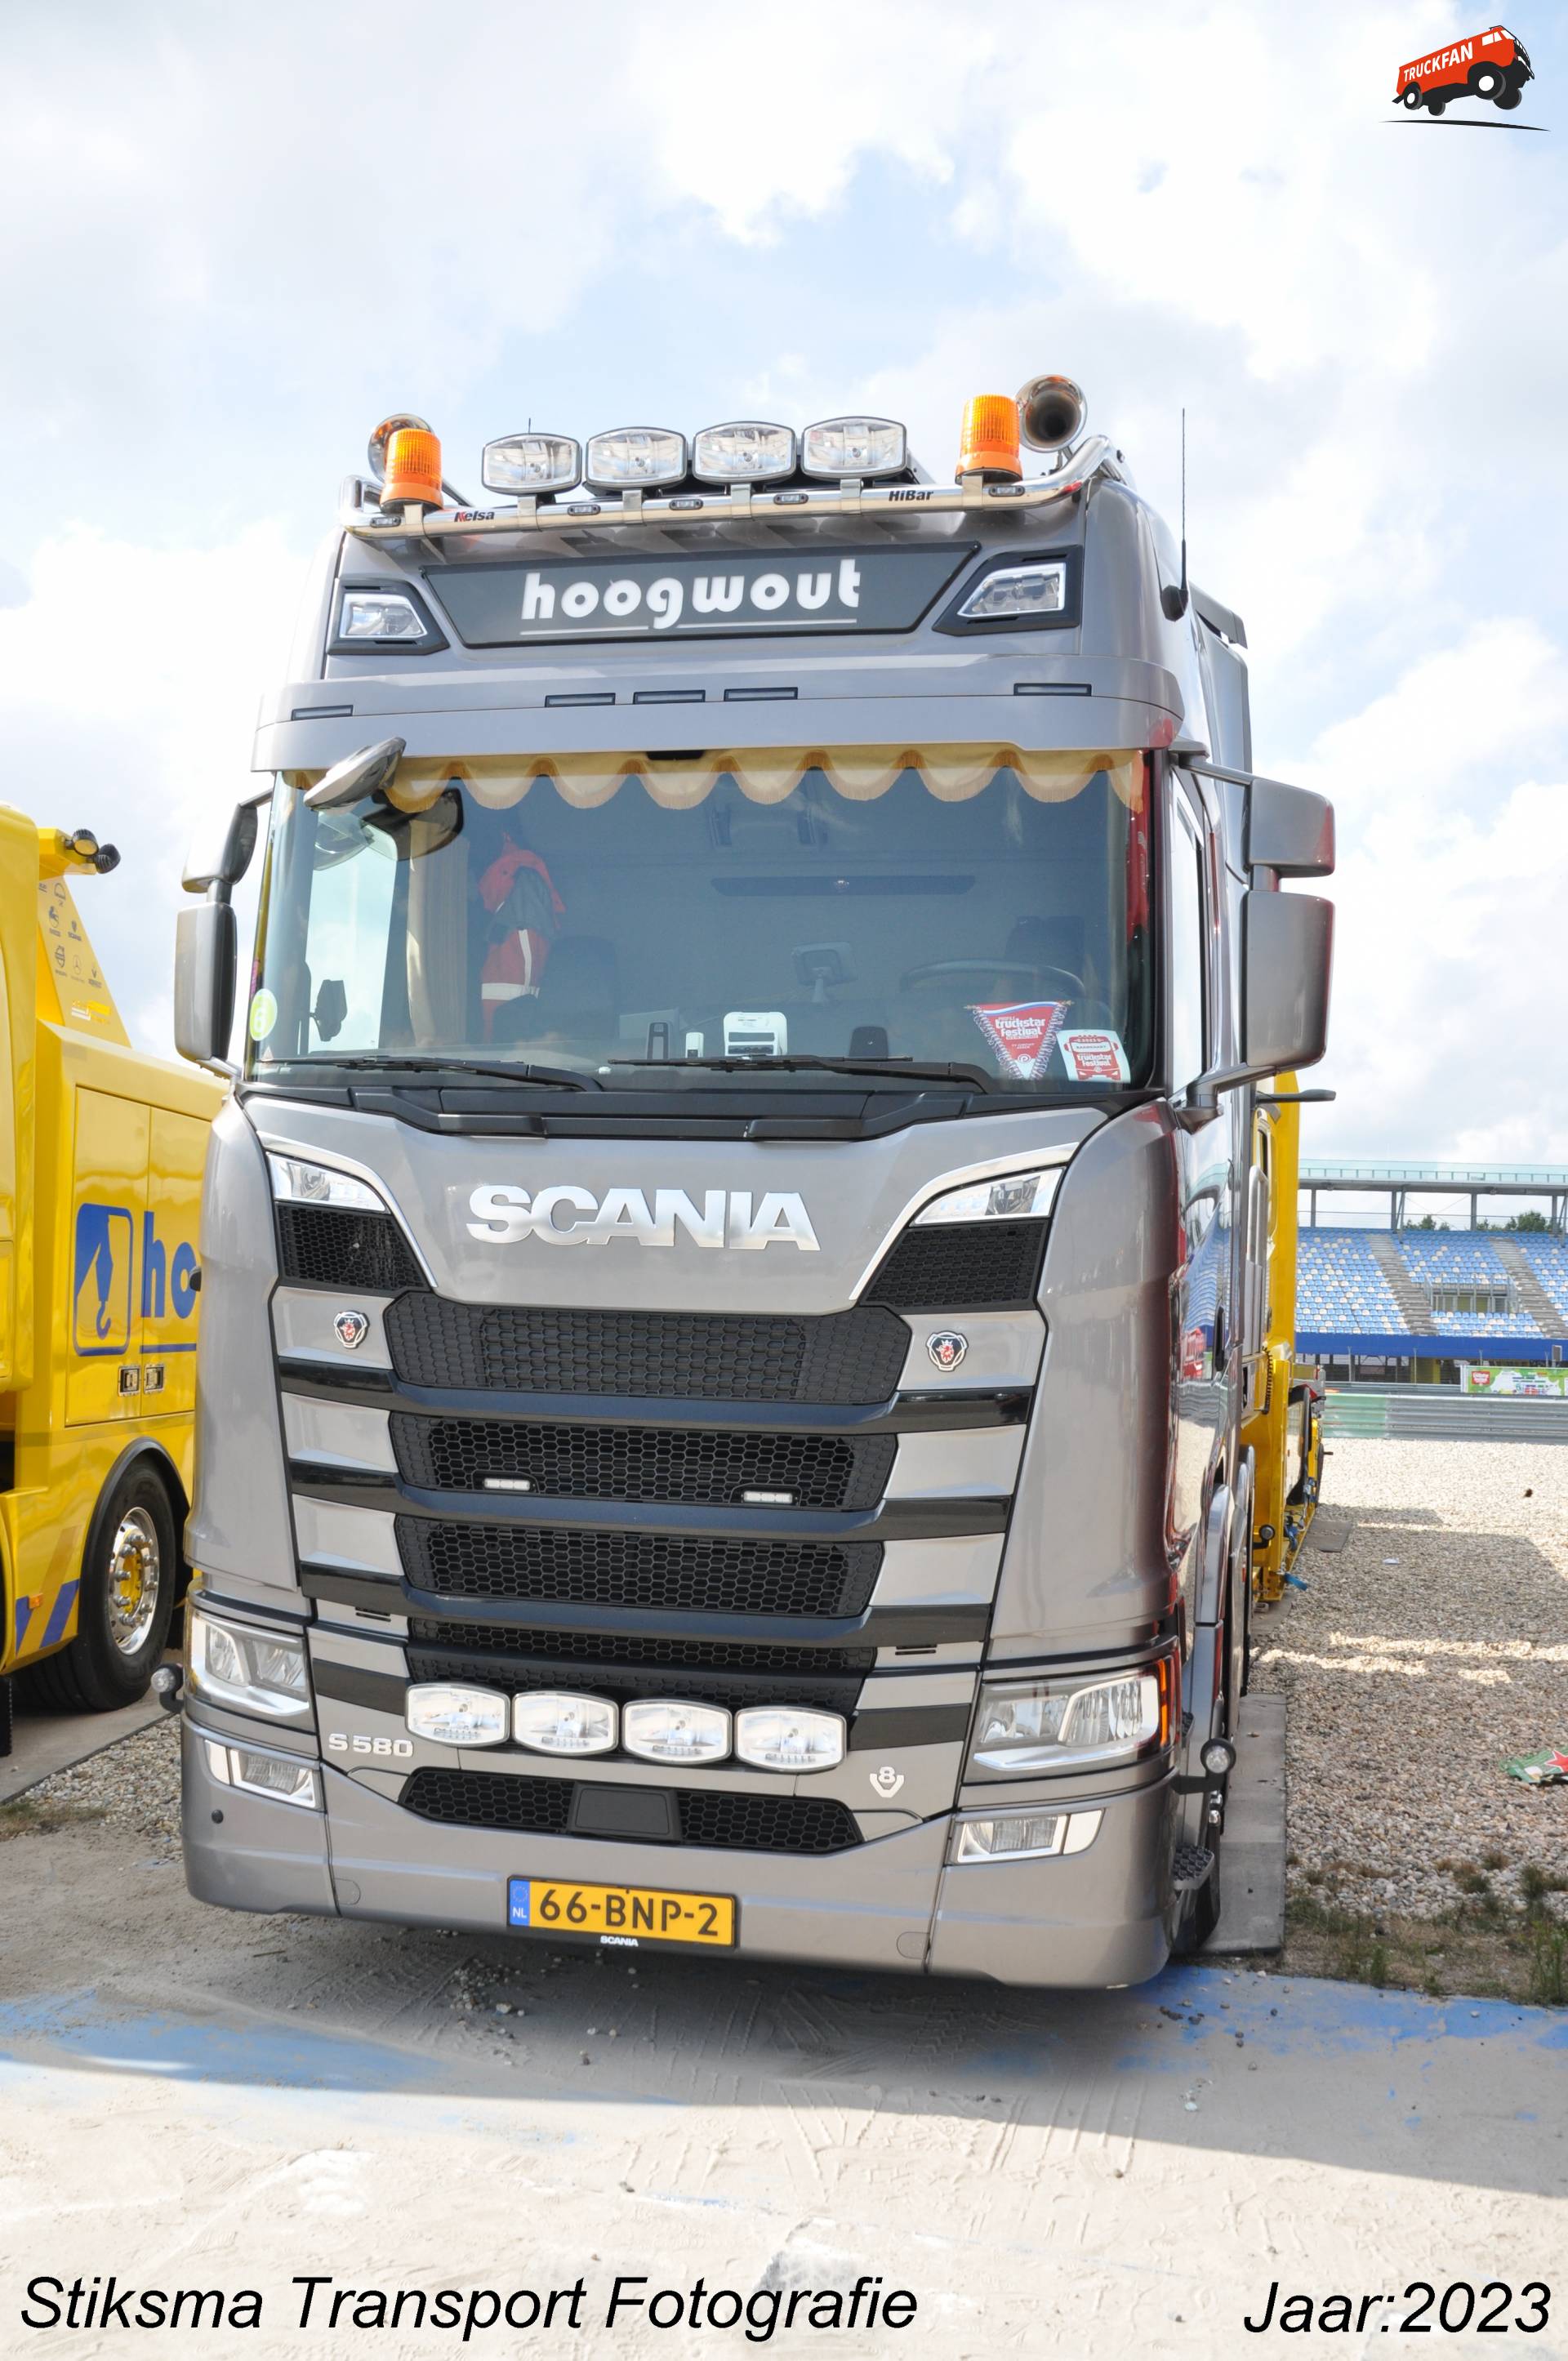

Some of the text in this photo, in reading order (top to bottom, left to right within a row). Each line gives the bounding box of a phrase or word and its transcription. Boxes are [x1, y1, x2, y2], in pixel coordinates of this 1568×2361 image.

[889, 489, 934, 501] HiBar
[454, 510, 495, 523] Kelsa
[520, 559, 862, 630] hoogwout
[466, 1185, 821, 1251] SCANIA
[328, 1733, 414, 1757] S 580
[513, 1889, 718, 1936] NL 66-BNP-2
[600, 1936, 639, 1947] SCANIA
